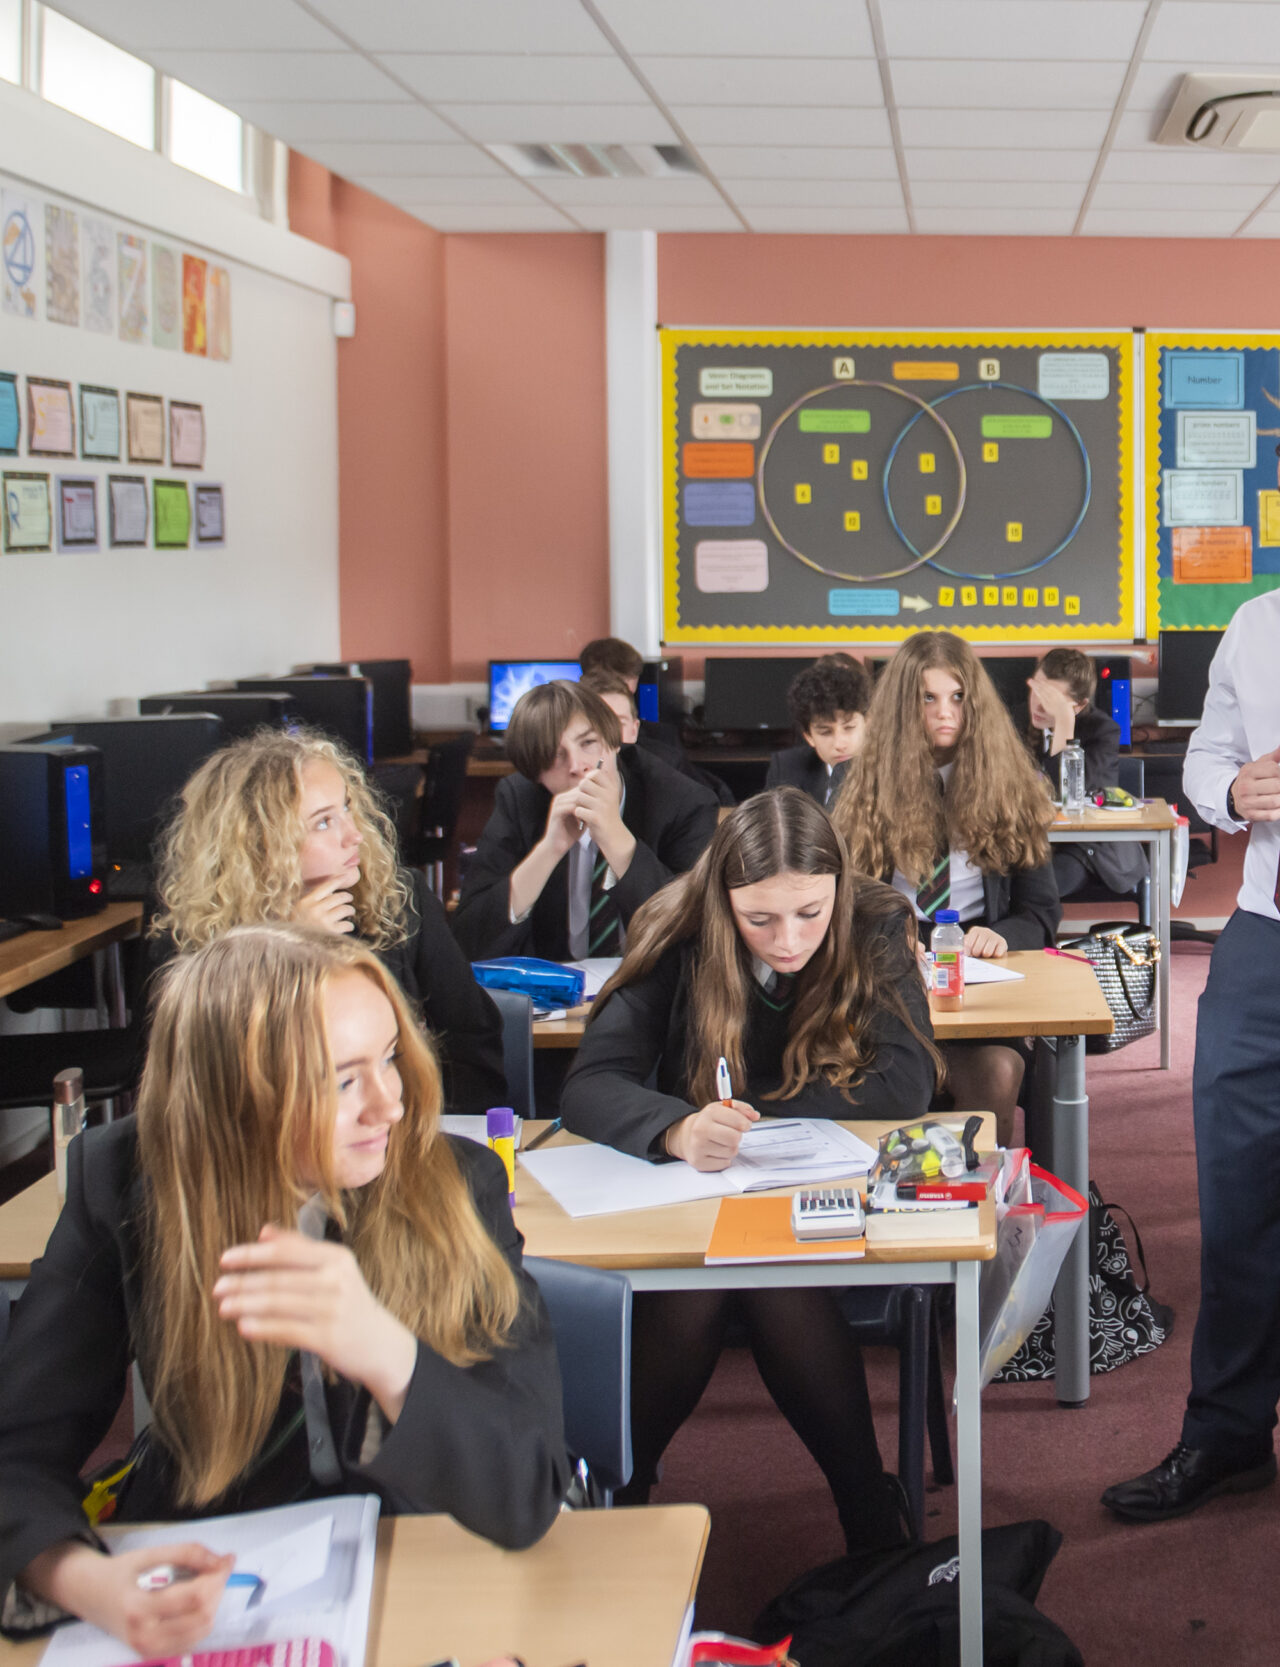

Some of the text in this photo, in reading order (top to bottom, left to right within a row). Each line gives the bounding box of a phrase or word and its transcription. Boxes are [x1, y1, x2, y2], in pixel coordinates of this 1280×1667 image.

[839, 361, 849, 374] A
[986, 364, 996, 376] B
[1187, 376, 1223, 385] Number
